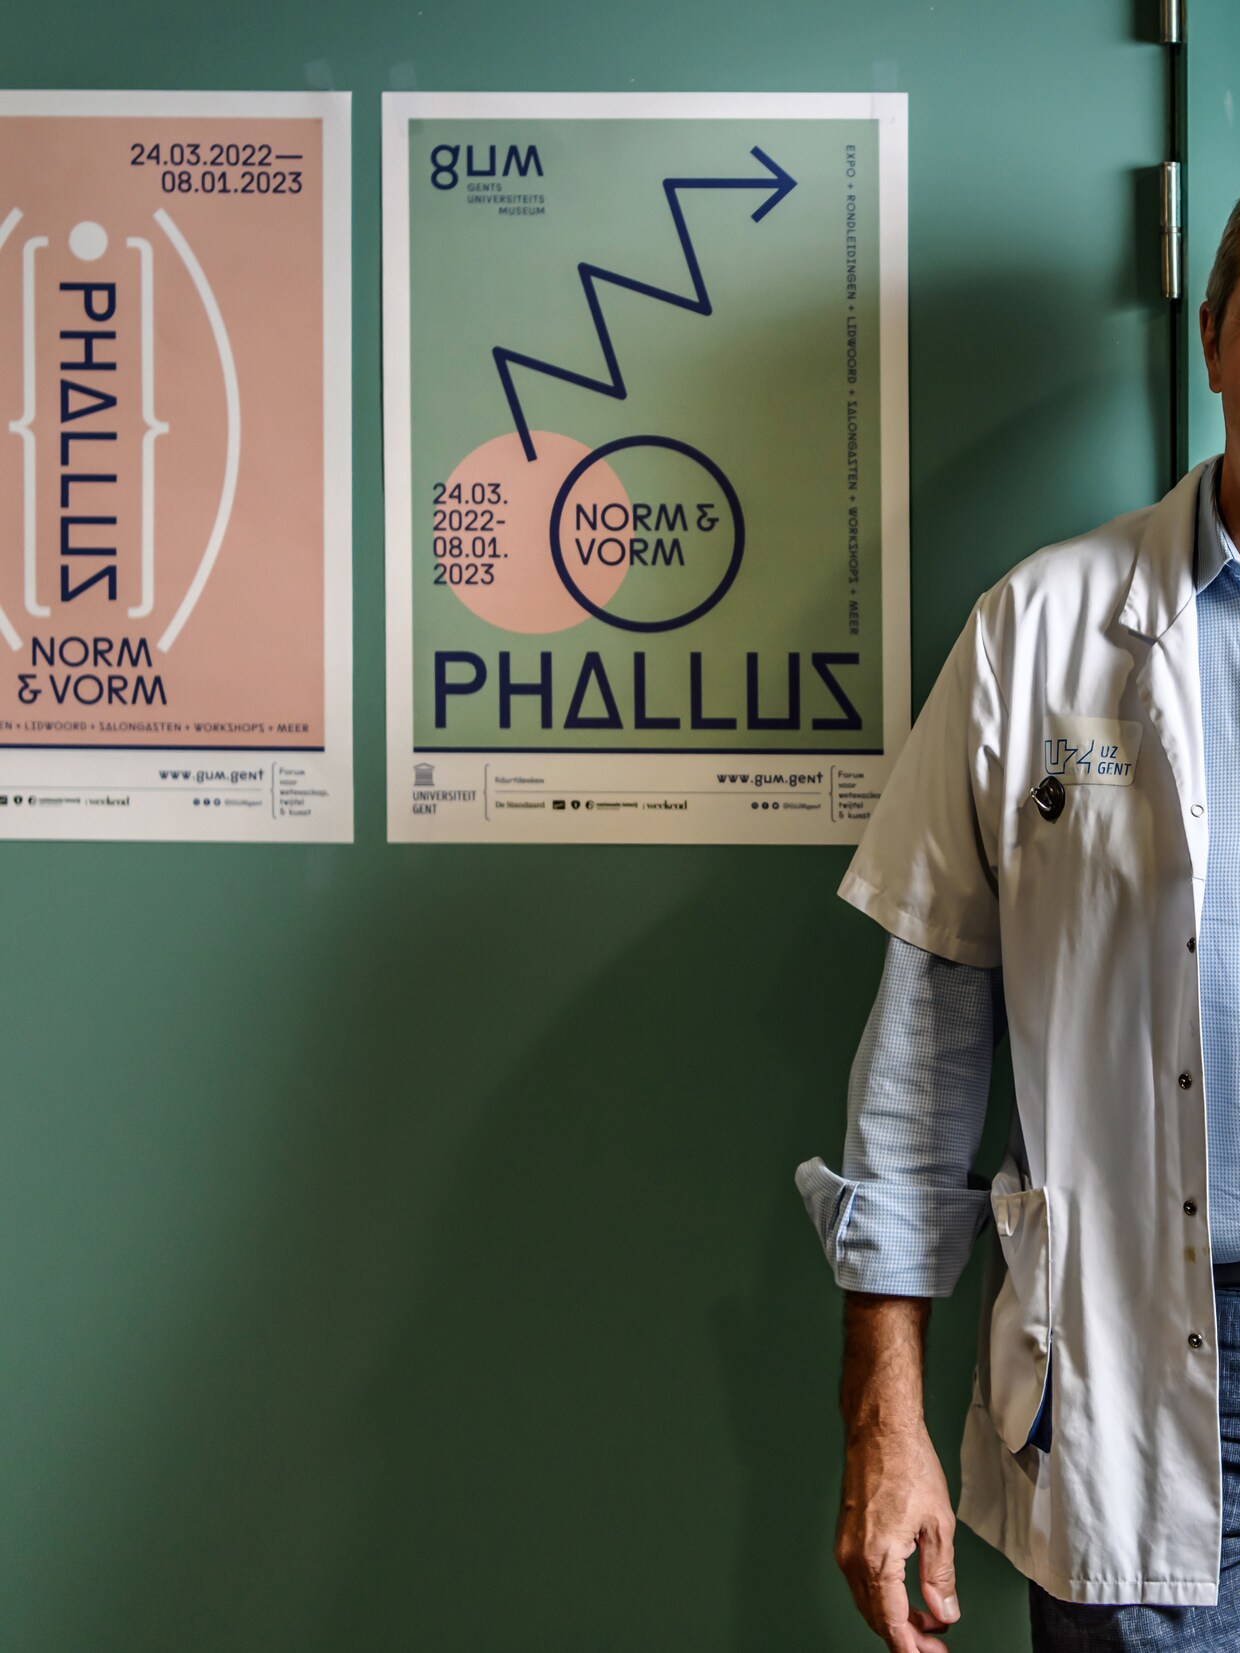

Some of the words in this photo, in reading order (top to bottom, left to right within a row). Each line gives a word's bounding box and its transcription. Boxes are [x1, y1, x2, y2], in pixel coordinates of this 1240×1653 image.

[845, 144, 857, 178] EXPO
[162, 171, 302, 194] 08.01.2023
[466, 182, 503, 193] GENTS
[467, 194, 545, 205] UNIVERSITEITS
[498, 206, 546, 216] MUSEUM
[846, 195, 857, 300] RONDLEIDINGEN
[846, 316, 858, 385] LIDWOORD
[846, 400, 859, 491] SALONGASTEN
[433, 482, 507, 505] 24.03.
[433, 510, 505, 531] 2022-
[576, 503, 688, 532] NORM
[697, 504, 719, 532] &
[433, 536, 508, 558] 08.01.
[575, 538, 685, 567] VORM
[847, 506, 860, 585] WORKSHOPS
[433, 563, 494, 585] 2023
[848, 600, 860, 636] MEER
[32, 637, 152, 667] NORM
[18, 674, 41, 704] &
[49, 674, 167, 705] VORM
[434, 651, 863, 730] PHALLUS
[24, 720, 88, 732] LIDWOORD
[99, 721, 182, 733] SALONGASTEN
[193, 722, 265, 734] WORKSHOPS
[276, 723, 309, 733] MEER
[1101, 745, 1119, 759] UZ
[159, 768, 265, 784] www.gum.gent
[717, 771, 824, 788] www.gum.gent
[1097, 761, 1133, 776] GENT
[412, 790, 477, 802] UNIVERSITEIT
[412, 803, 437, 815] GENT
